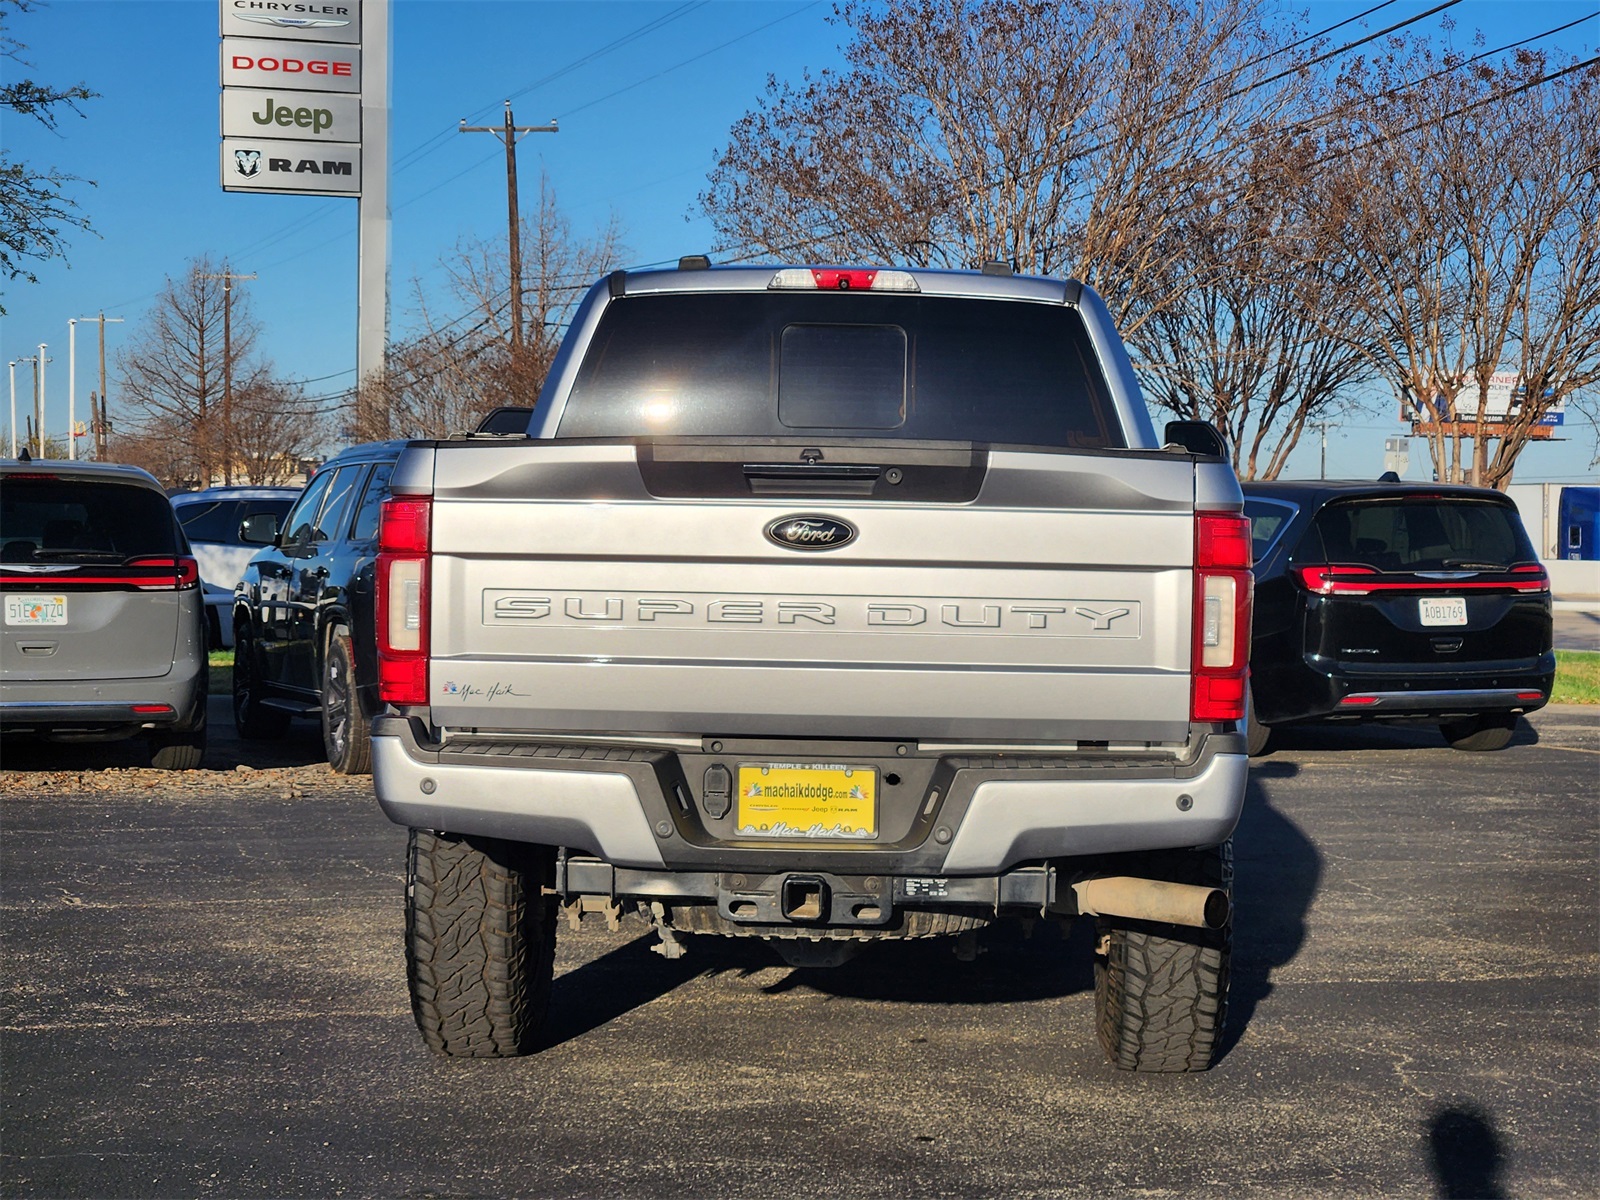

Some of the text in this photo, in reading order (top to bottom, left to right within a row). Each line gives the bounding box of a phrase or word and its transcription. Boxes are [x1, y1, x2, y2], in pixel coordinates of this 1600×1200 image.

[234, 1, 349, 16] CHRYSLER
[232, 56, 352, 77] DODGE
[252, 98, 333, 134] Jeep
[269, 158, 352, 175] RAM
[786, 521, 836, 542] Ford
[495, 597, 1130, 630] SUPER DUTY
[460, 684, 484, 702] Mac
[812, 763, 847, 771] KILLEEN
[764, 783, 848, 802] machaikdodge.com
[768, 821, 846, 838] Mac Haik
